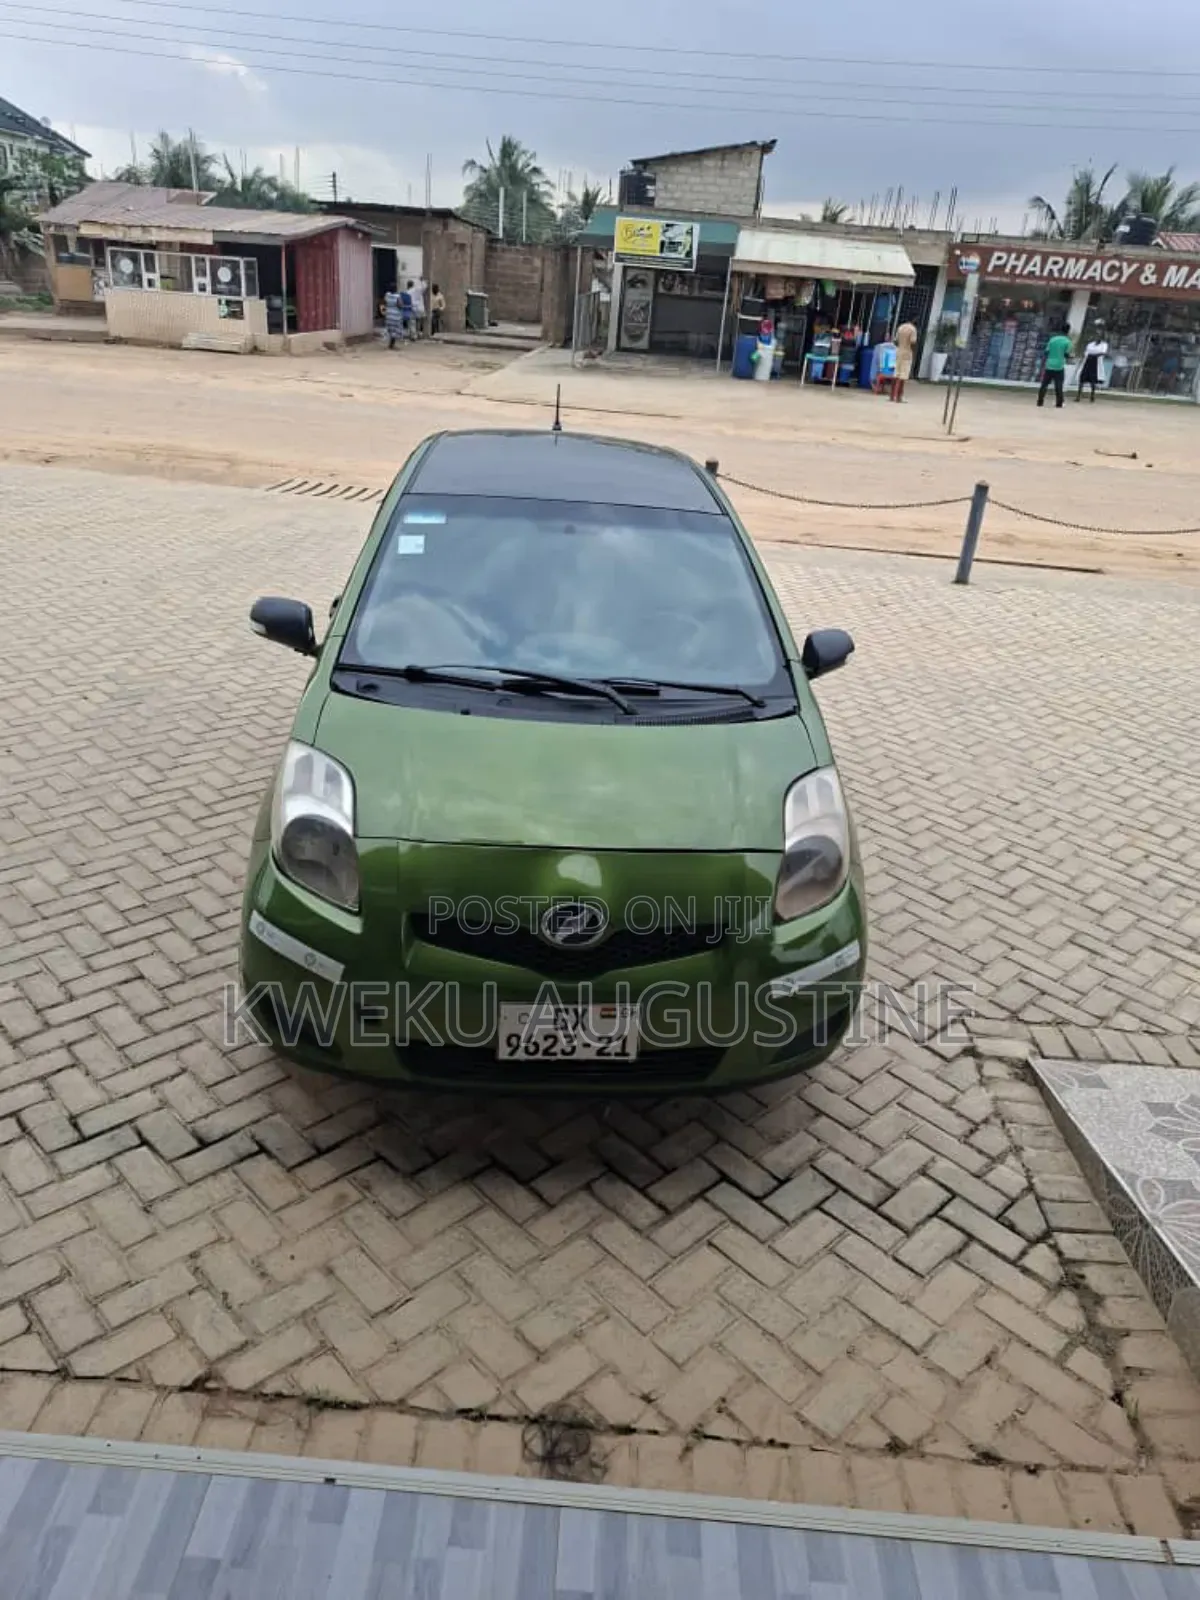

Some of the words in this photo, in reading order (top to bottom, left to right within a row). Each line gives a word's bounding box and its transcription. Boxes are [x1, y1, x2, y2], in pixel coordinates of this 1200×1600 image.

[986, 251, 1140, 284] PHARMACY
[1139, 262, 1158, 286] &
[506, 1033, 630, 1057] 9623-21
